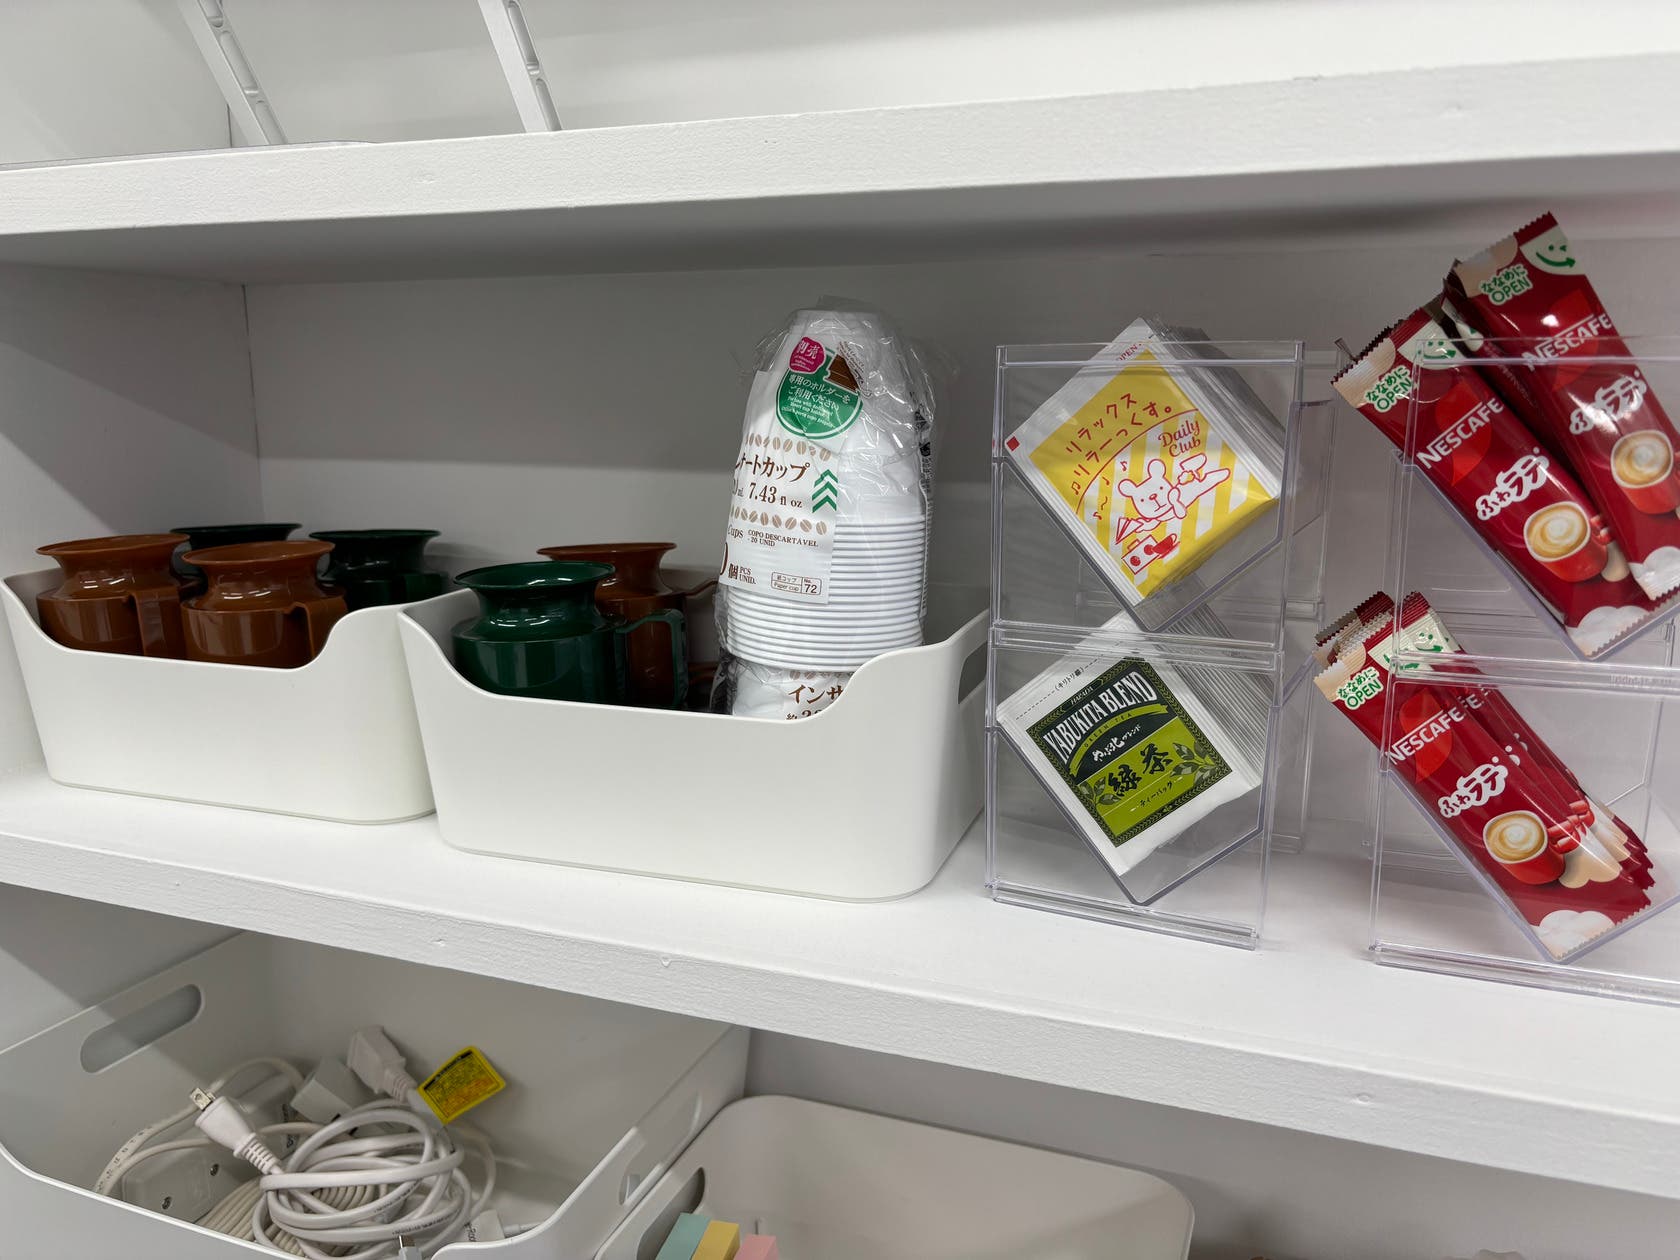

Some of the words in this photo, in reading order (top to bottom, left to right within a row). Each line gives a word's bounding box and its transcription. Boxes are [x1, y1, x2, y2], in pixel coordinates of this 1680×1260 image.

[1480, 264, 1527, 293] ななめに
[1490, 278, 1532, 304] OPEN
[788, 374, 850, 404] 専用のホルダーを
[1365, 364, 1410, 403] ななめに
[1376, 377, 1414, 411] OPEN
[1569, 376, 1647, 434] ふラテ
[1066, 393, 1136, 453] リラックス
[1158, 419, 1200, 448] Daily
[1169, 438, 1201, 457] Club
[749, 482, 777, 503] 7.43
[790, 500, 803, 508] oz
[748, 529, 764, 539] COPO
[750, 536, 758, 544] 20
[759, 538, 776, 547] UNID
[739, 566, 752, 576] PCS
[804, 583, 817, 594] 72
[1337, 667, 1379, 698] ななめに
[1347, 679, 1383, 709] OPEN
[1043, 701, 1106, 764] YABUKITA
[1098, 671, 1157, 713] BLEND
